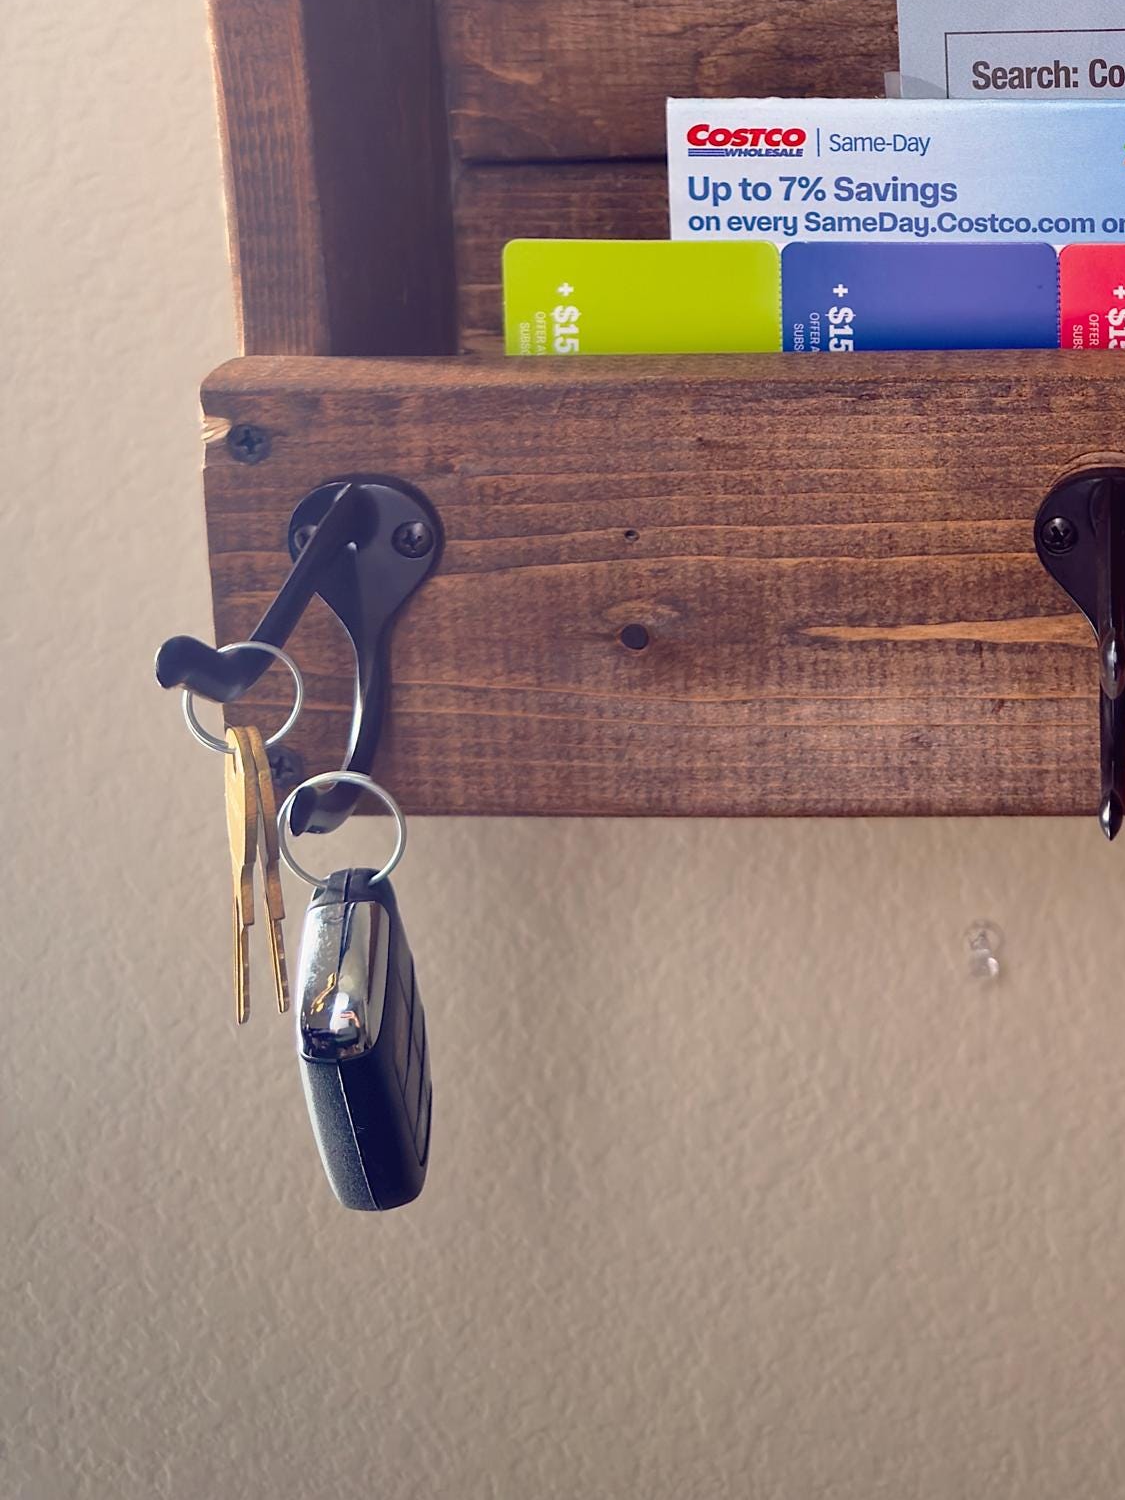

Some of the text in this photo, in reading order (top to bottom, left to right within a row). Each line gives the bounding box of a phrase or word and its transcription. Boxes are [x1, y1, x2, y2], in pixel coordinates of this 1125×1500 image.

[972, 60, 1079, 90] Search:
[687, 124, 807, 147] COSTCO
[829, 133, 931, 157] Same-Day
[724, 148, 804, 158] WHOLESALE
[688, 175, 958, 209] Up to 7% Savings
[688, 214, 720, 232] on
[727, 214, 798, 237] every
[804, 211, 1096, 238] SameDay.Costco.com
[809, 312, 821, 344] OFFER
[825, 306, 856, 352] $15
[1088, 313, 1100, 346] OFFER
